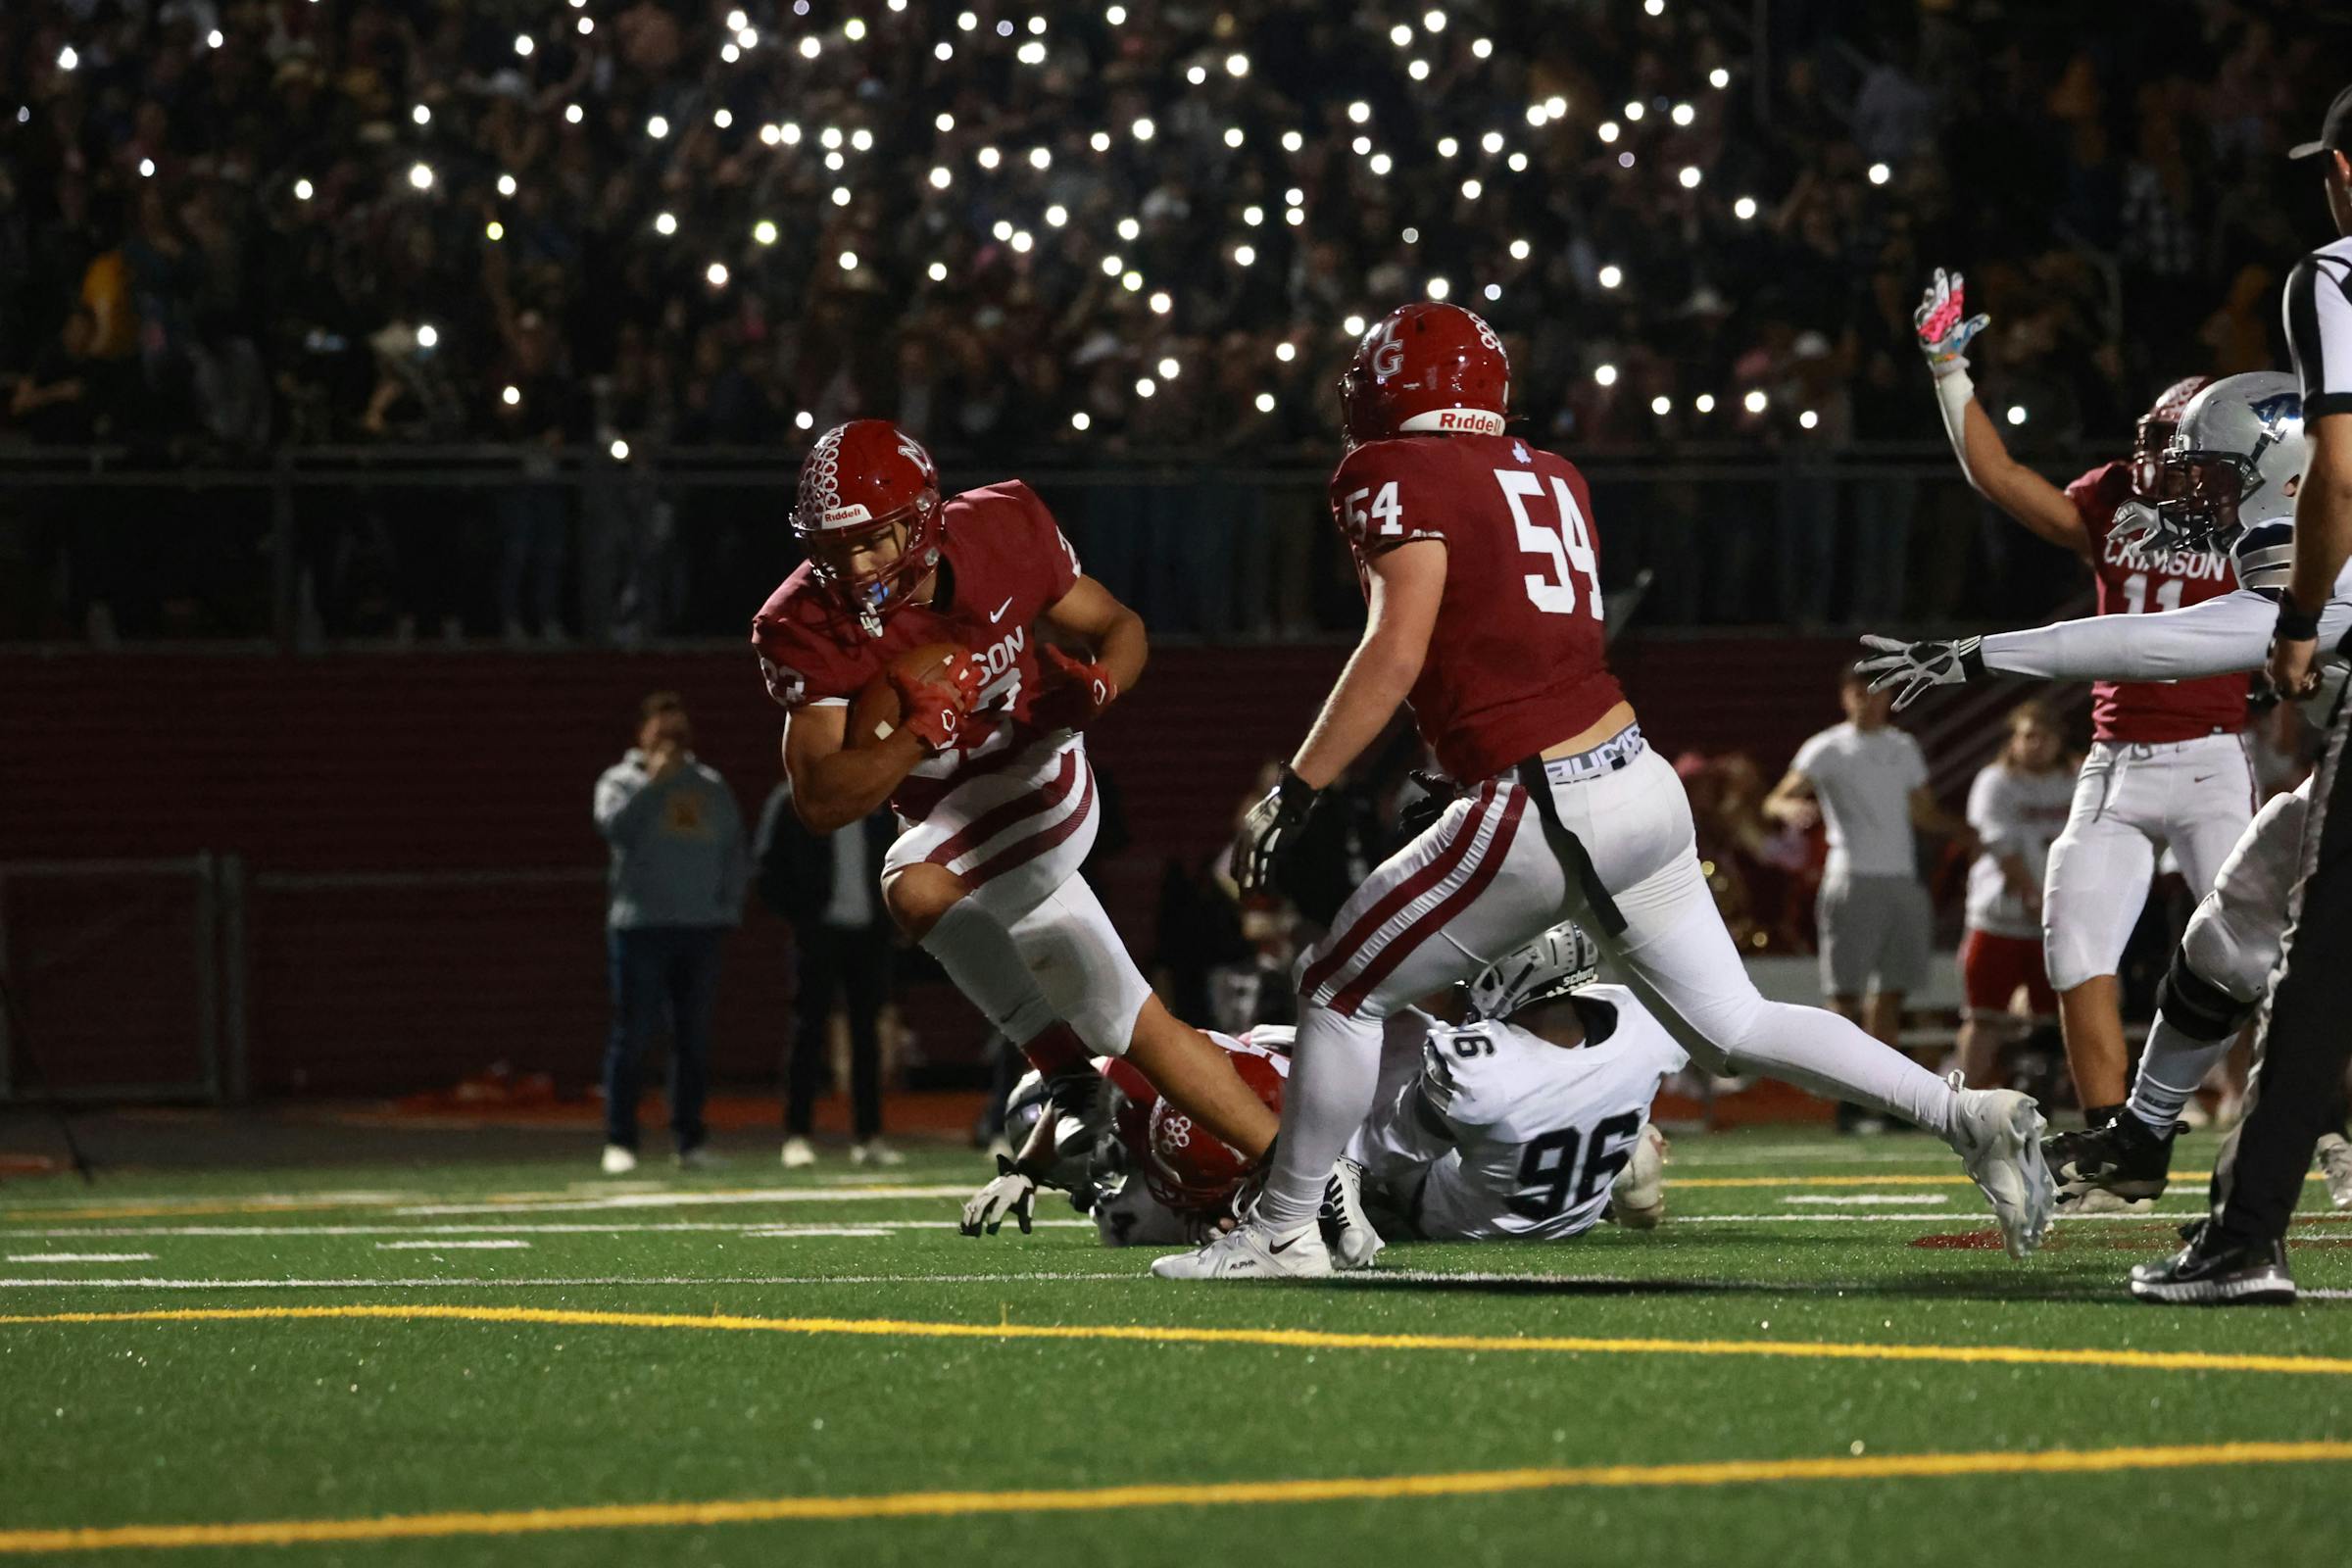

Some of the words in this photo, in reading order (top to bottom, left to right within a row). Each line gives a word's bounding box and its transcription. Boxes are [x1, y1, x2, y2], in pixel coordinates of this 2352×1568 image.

[1440, 413, 1501, 432] Riddell
[824, 508, 860, 523] Riddell
[1344, 480, 1403, 542] 54
[1494, 468, 1604, 621] 54
[2123, 572, 2184, 614] 11
[1501, 1108, 1642, 1221] 96
